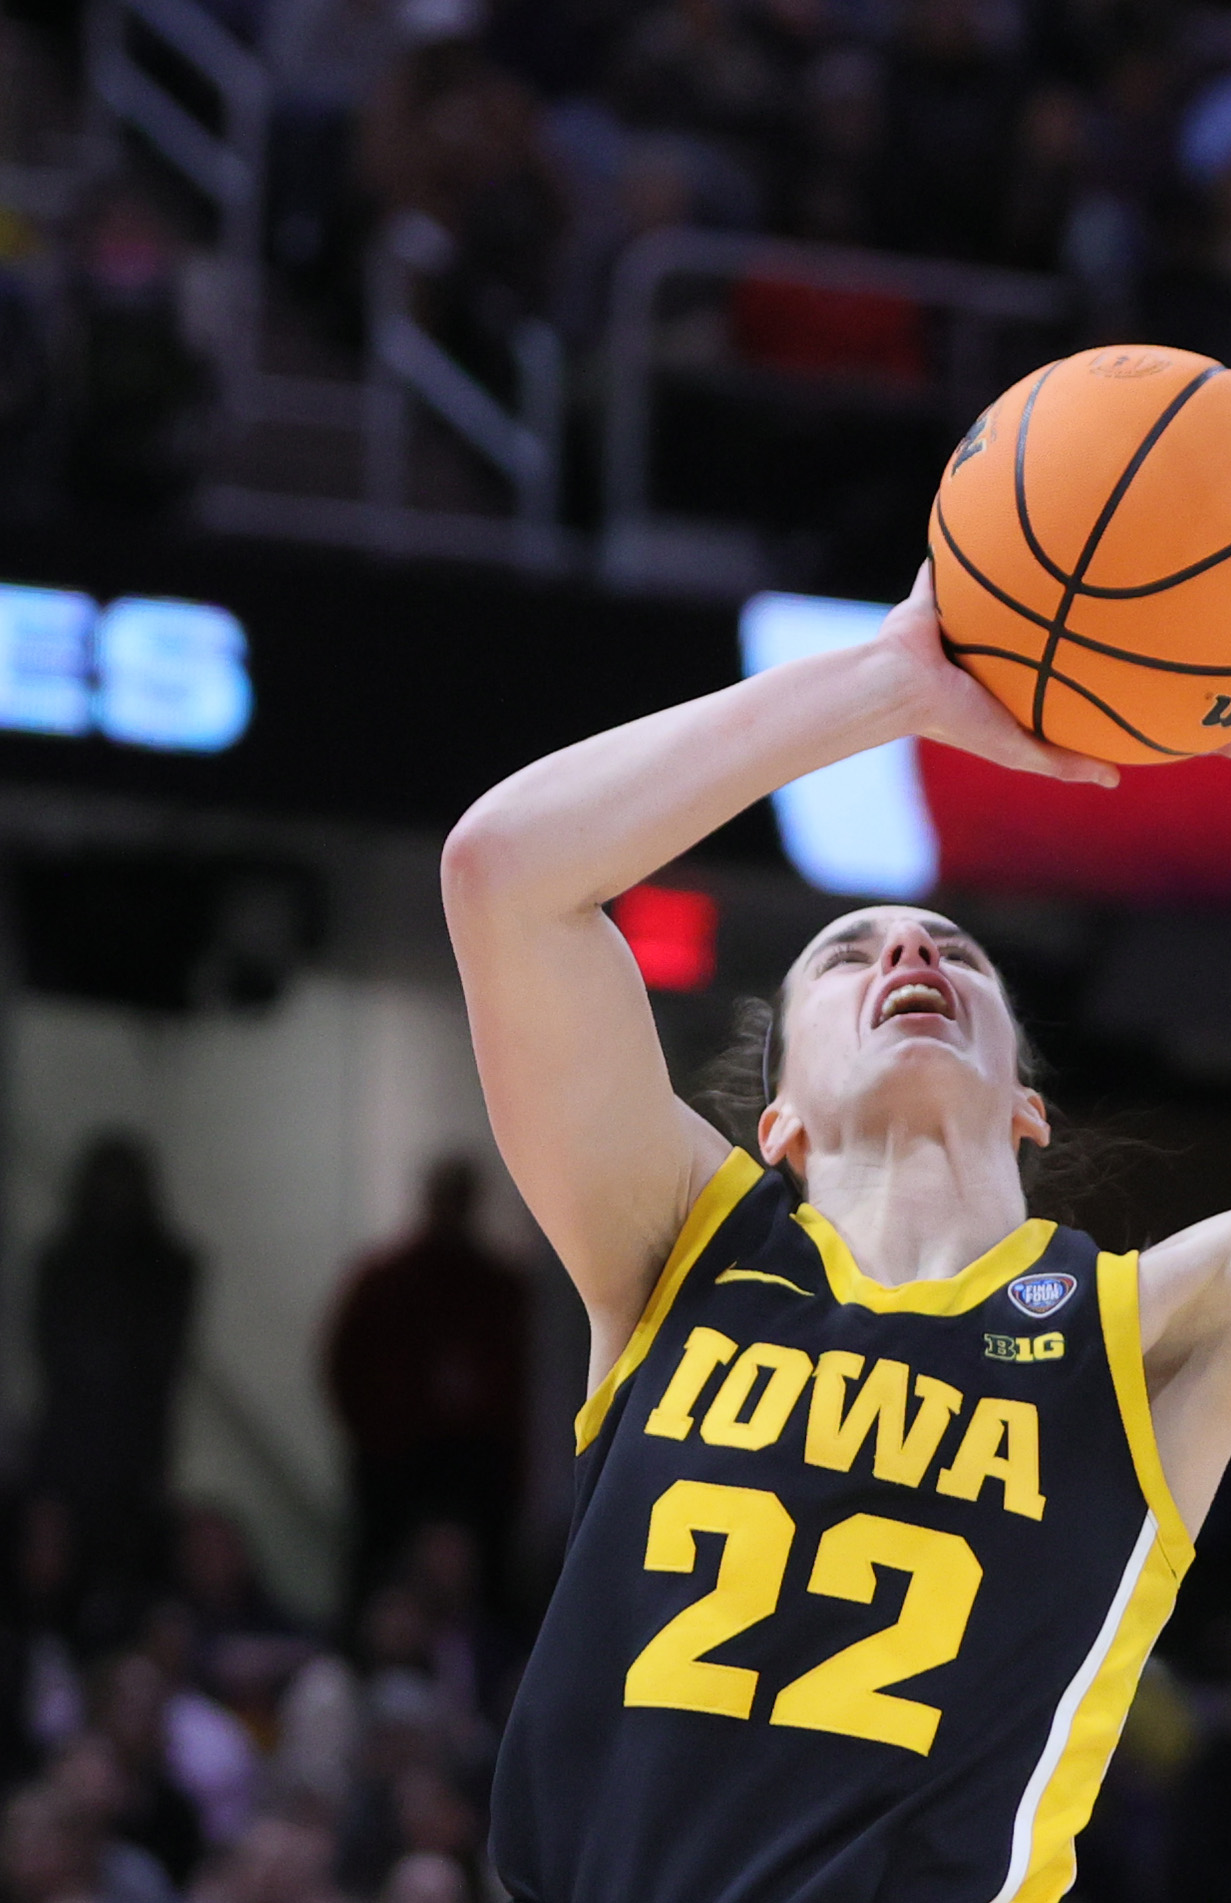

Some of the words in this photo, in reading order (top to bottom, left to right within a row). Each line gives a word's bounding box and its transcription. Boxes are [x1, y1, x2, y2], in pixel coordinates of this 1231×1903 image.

[1025, 1282, 1059, 1294] FINAL
[1025, 1291, 1060, 1303] FOUR
[644, 1327, 1046, 1520] IOWA
[624, 1480, 983, 1757] 22
